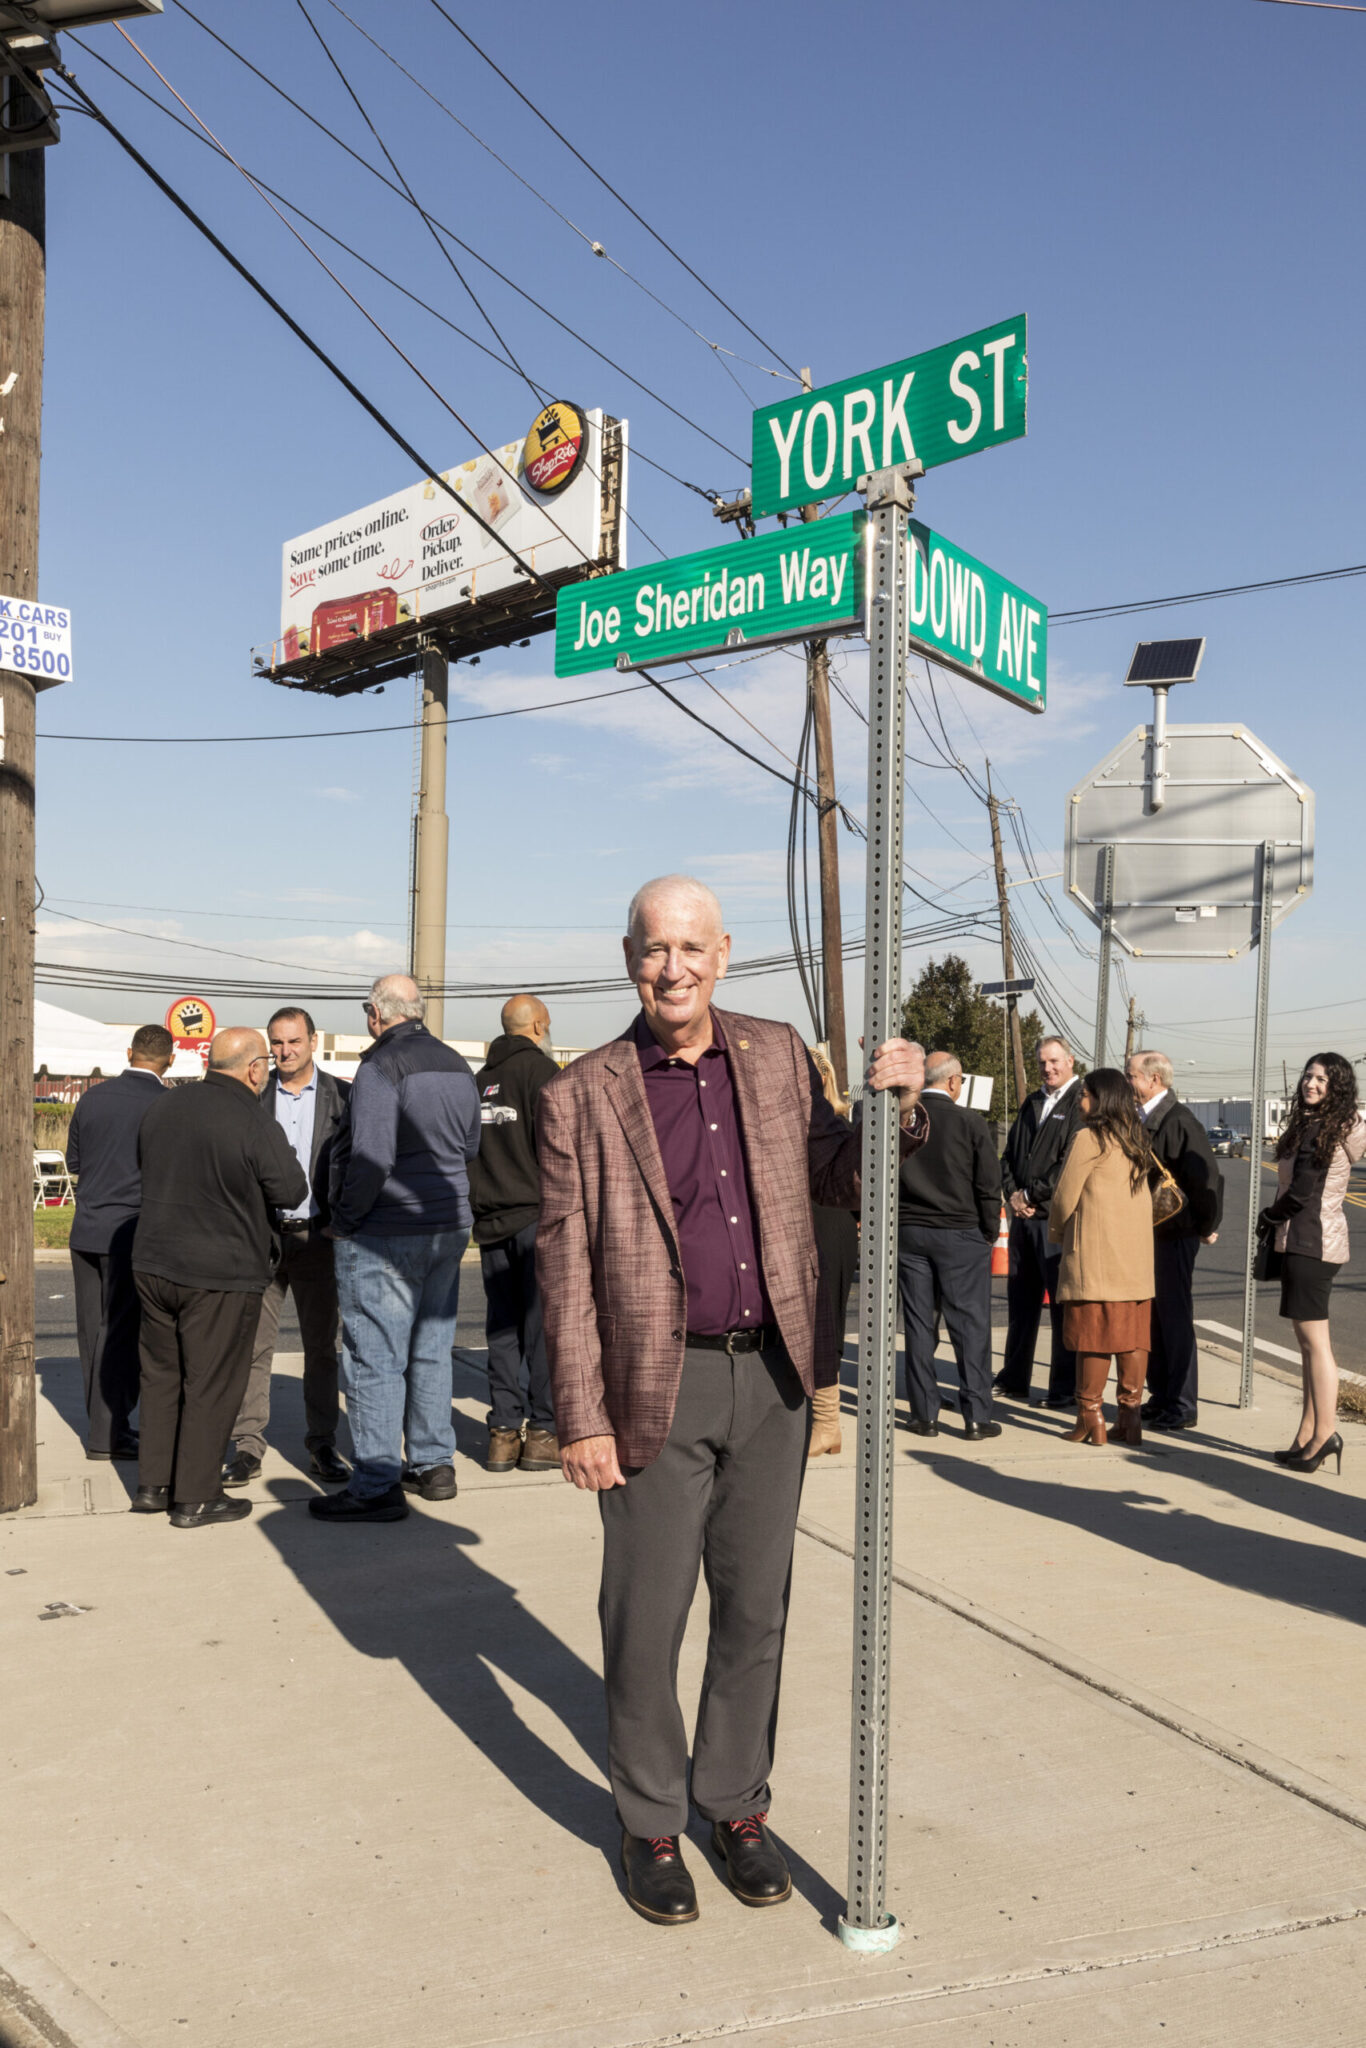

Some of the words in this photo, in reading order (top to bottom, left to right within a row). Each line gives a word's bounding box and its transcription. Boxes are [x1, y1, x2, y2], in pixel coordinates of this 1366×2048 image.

[769, 371, 918, 499] YORK
[947, 333, 1016, 445] ST
[532, 443, 578, 485] ShopRite
[290, 544, 322, 567] Same
[324, 527, 362, 558] prices
[364, 508, 409, 537] online.
[422, 536, 462, 560] Pickup.
[423, 519, 455, 540] Order.
[289, 568, 316, 590] Save
[318, 554, 350, 579] some
[353, 541, 385, 565] time.
[422, 556, 463, 581] Deliver.
[19, 604, 68, 629] CARS
[573, 601, 621, 651] Joe
[634, 568, 765, 637] Sheridan
[779, 548, 848, 606] Way
[910, 534, 986, 658] DOWD
[996, 592, 1041, 692] AVE
[43, 631, 62, 642] BUY
